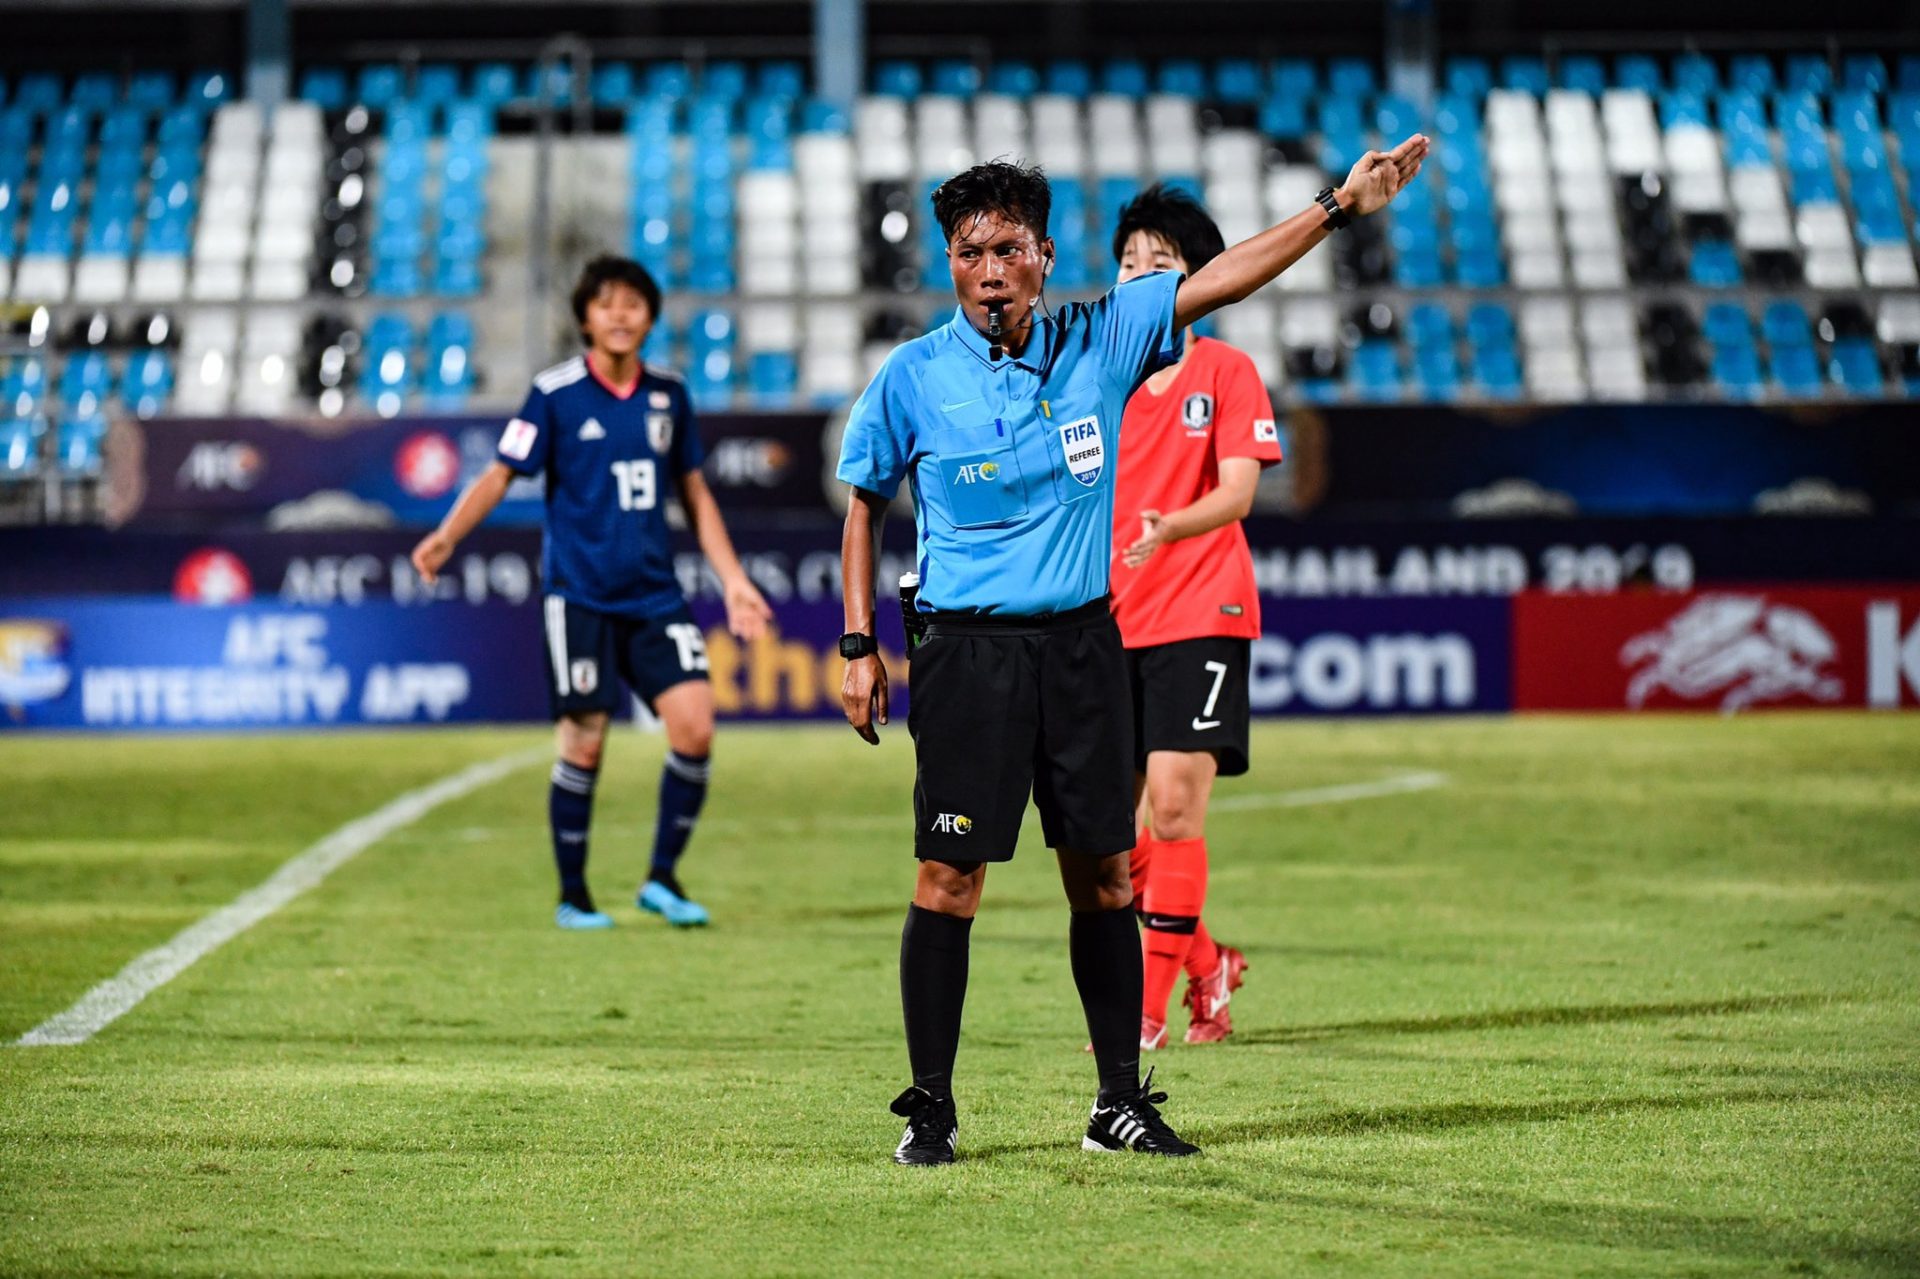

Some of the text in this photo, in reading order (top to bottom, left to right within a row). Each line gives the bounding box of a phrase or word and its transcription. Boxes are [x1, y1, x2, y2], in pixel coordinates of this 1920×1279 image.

[1064, 421, 1096, 445] FIFA
[1068, 446, 1101, 464] REFEREE
[610, 458, 656, 511] 19
[953, 461, 999, 486] AFC
[1080, 470, 1097, 482] 2019
[280, 553, 382, 606] AFC
[1252, 546, 1528, 596] HAILAND
[223, 614, 328, 666] AFC
[82, 663, 470, 723] INTEGRITY APP
[1204, 660, 1227, 717] 7
[931, 812, 972, 835] AFC
